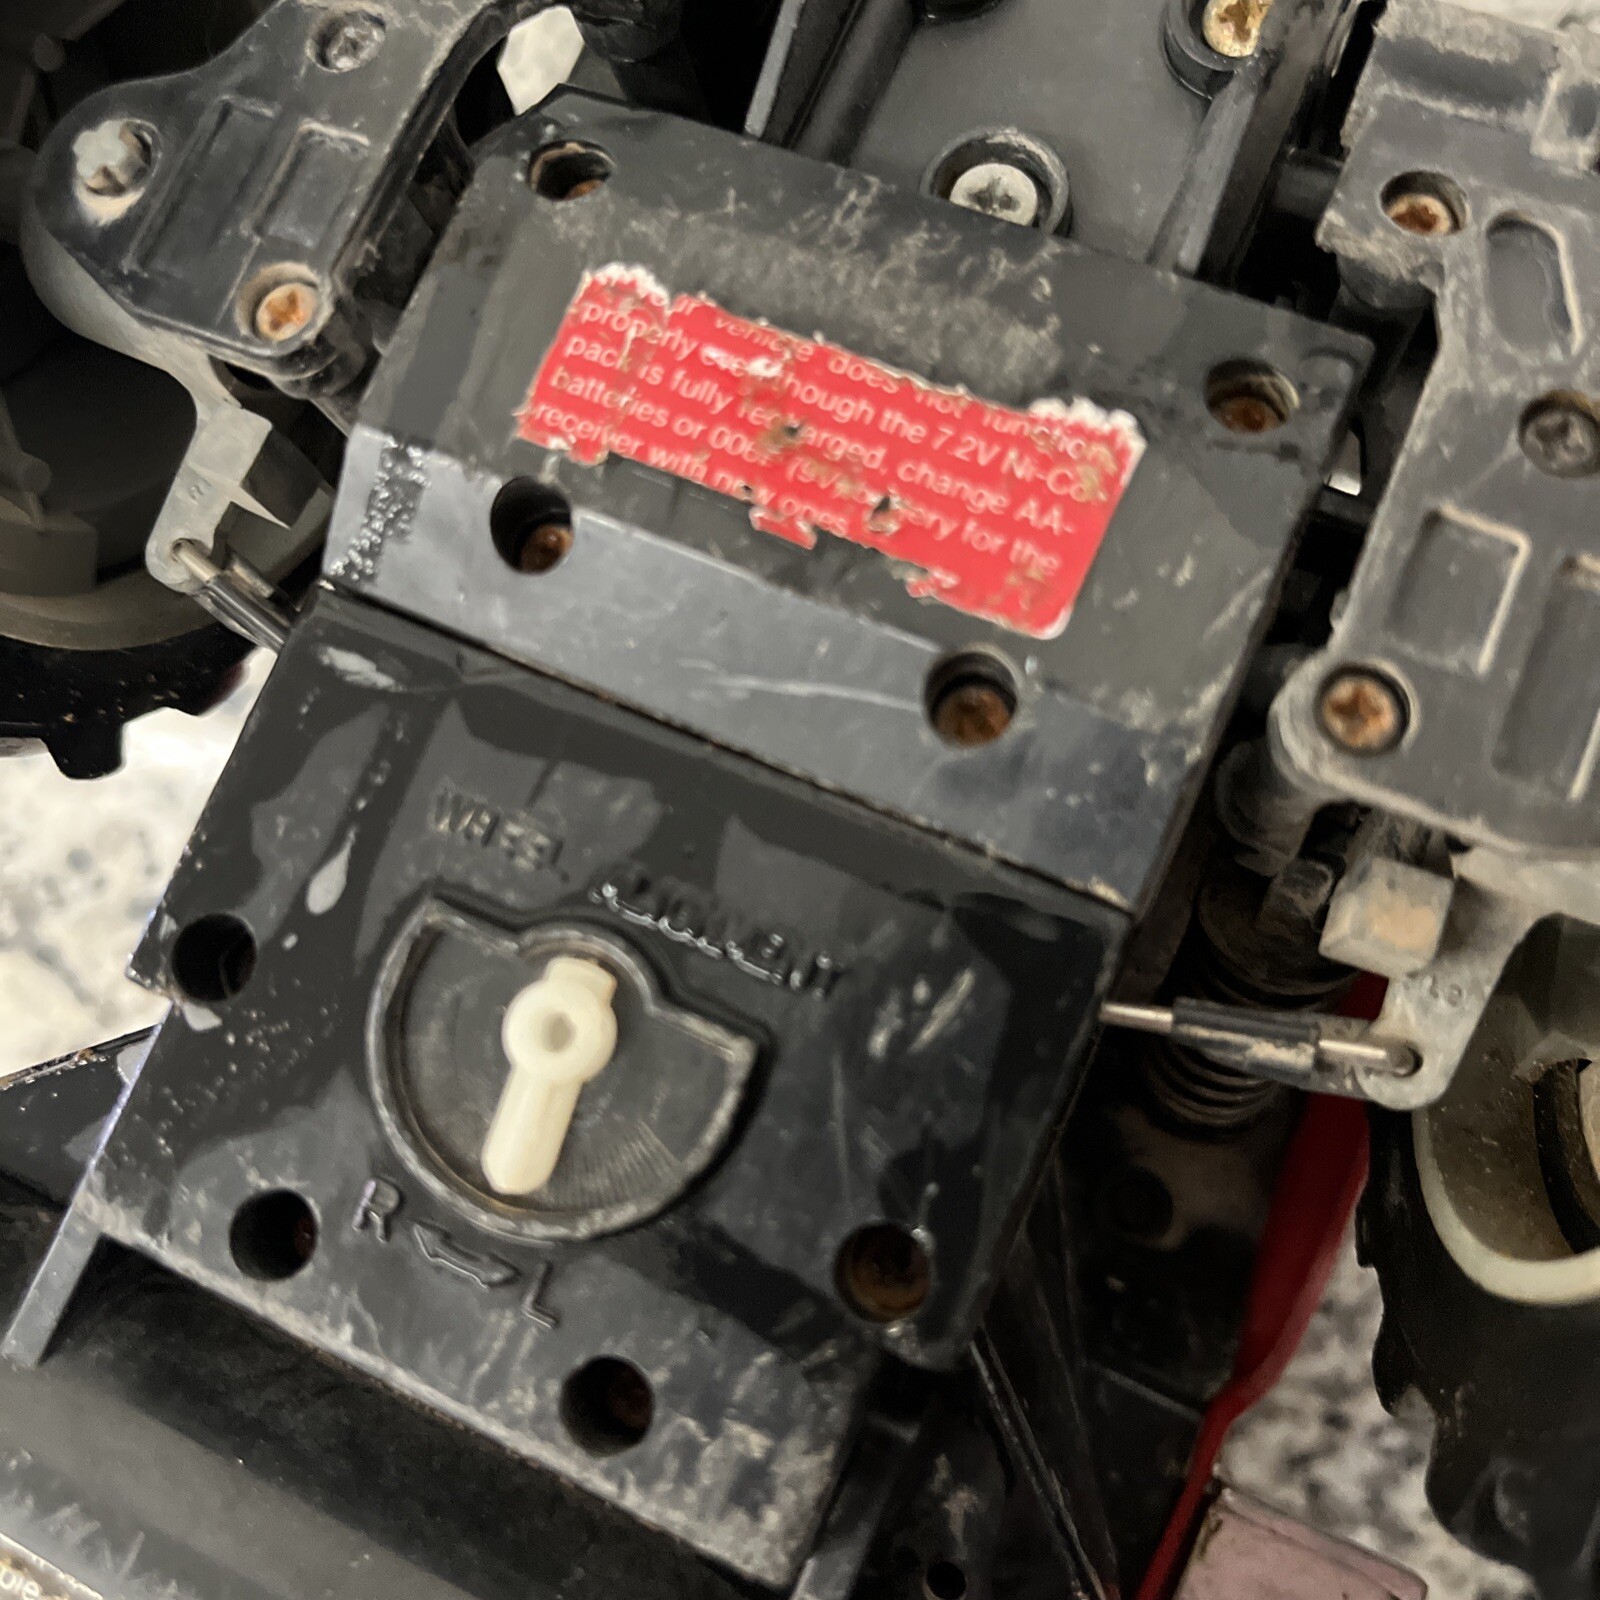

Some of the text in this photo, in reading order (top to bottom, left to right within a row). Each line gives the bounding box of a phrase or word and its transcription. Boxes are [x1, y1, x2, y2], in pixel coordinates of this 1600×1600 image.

[534, 402, 645, 456] receiver
[649, 446, 707, 478] with
[582, 302, 698, 361] properly
[701, 345, 784, 379] eve
[779, 366, 875, 424] hough
[878, 410, 927, 444] the
[639, 363, 664, 385] is
[670, 370, 734, 415] fully
[897, 459, 1007, 515] change
[1013, 499, 1076, 535] AA-
[714, 315, 814, 362] vehice
[828, 352, 900, 394] does
[982, 411, 1118, 476] functio
[550, 366, 670, 427] batteries
[672, 415, 707, 438] or
[961, 518, 1007, 554] for
[1009, 538, 1061, 576] the
[352, 1176, 560, 1329] R L
